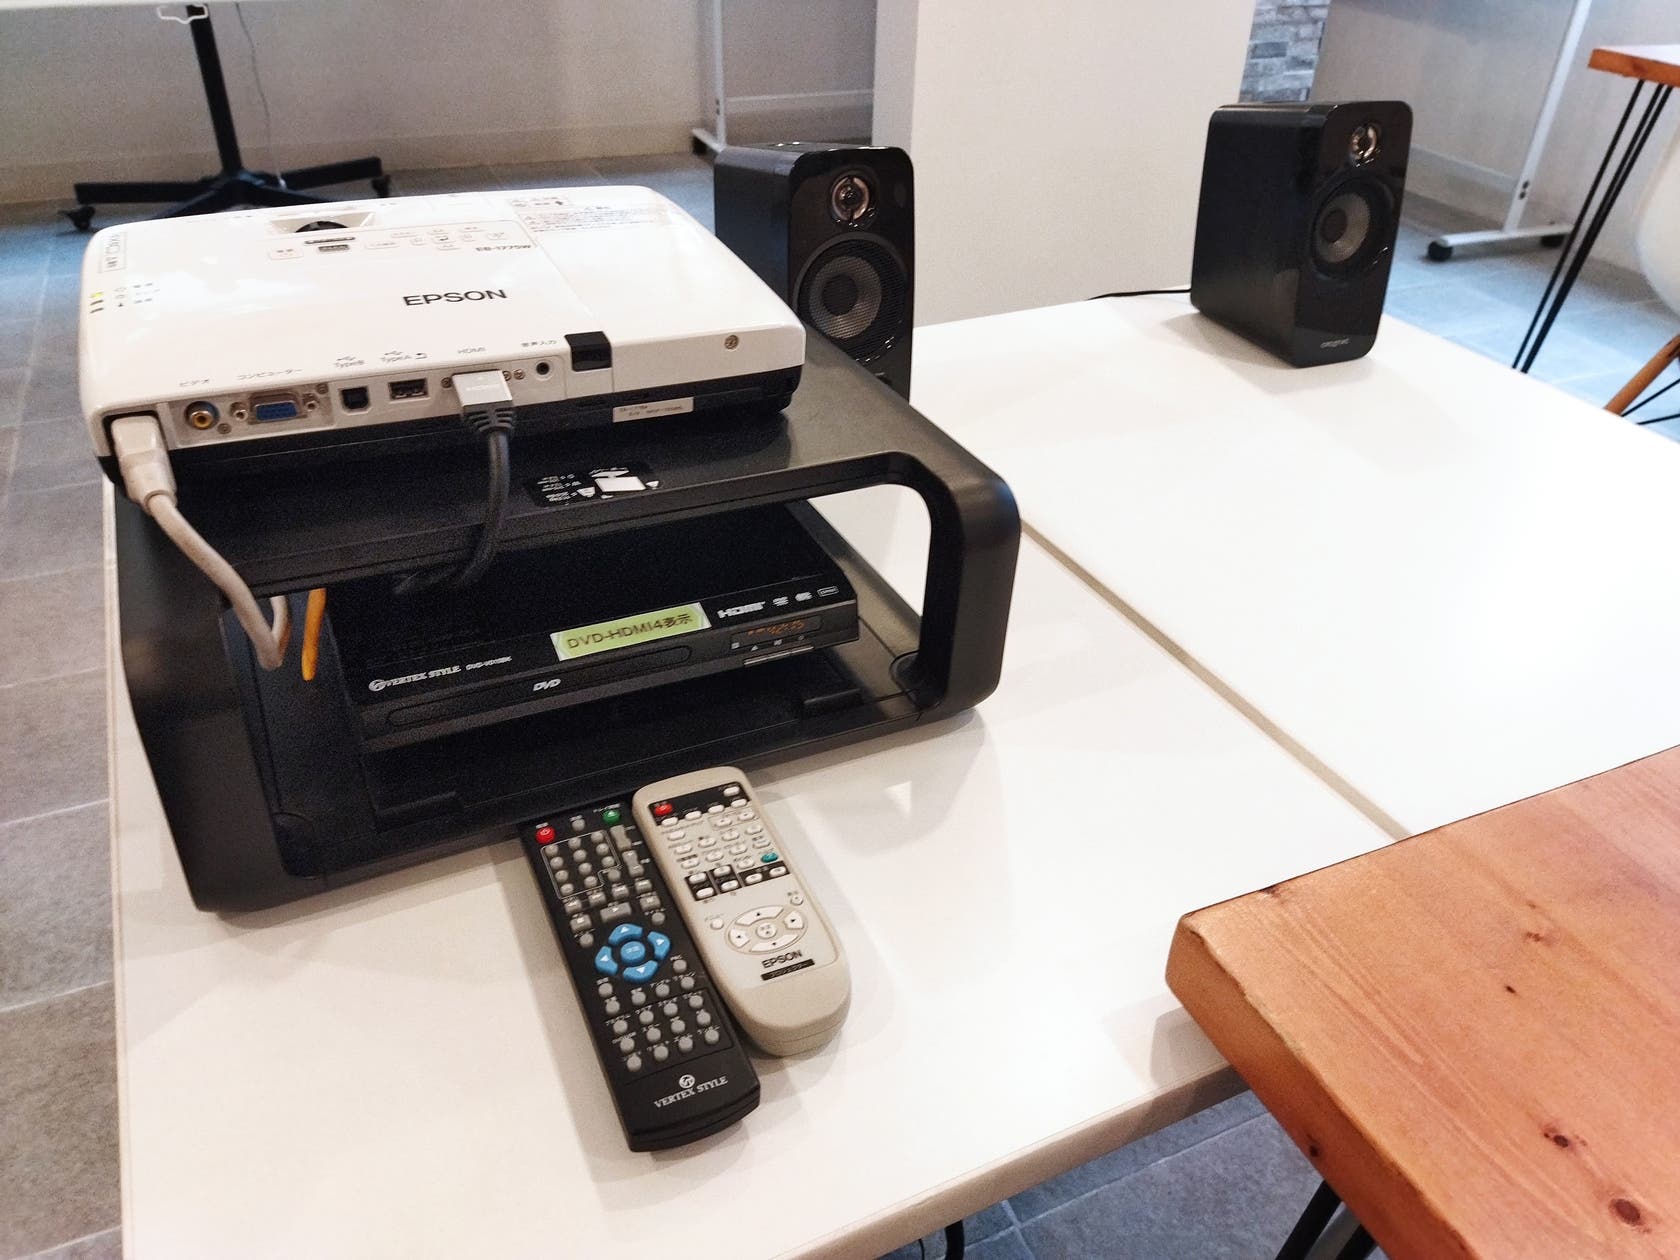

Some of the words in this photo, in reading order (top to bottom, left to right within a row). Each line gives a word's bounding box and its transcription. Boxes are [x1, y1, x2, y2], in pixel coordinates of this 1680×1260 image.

[402, 289, 508, 306] EPSON
[427, 665, 462, 679] STYLE
[532, 677, 562, 692] DVD
[761, 949, 803, 969] EPSON
[653, 1086, 696, 1108] VERTEX
[696, 1075, 729, 1093] STYLE
